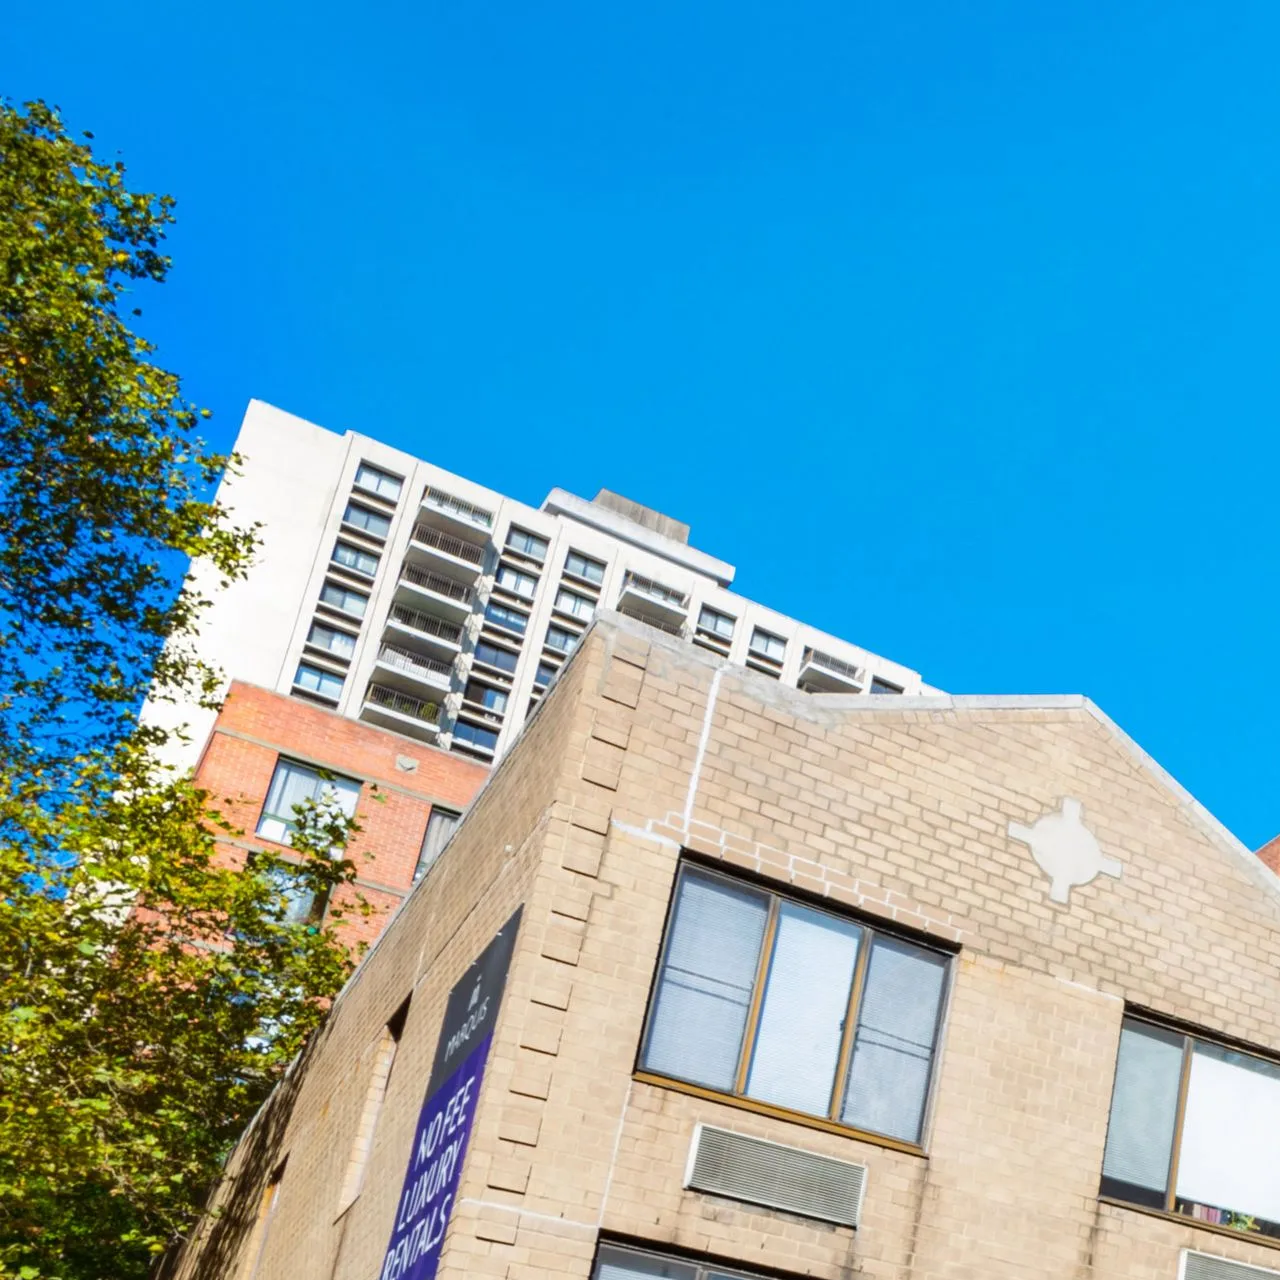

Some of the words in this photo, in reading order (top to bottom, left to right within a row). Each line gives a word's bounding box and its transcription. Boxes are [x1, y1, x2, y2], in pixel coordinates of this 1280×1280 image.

[414, 1111, 443, 1171] NO
[438, 1076, 475, 1146] FEE
[397, 1132, 465, 1232] LUXURY
